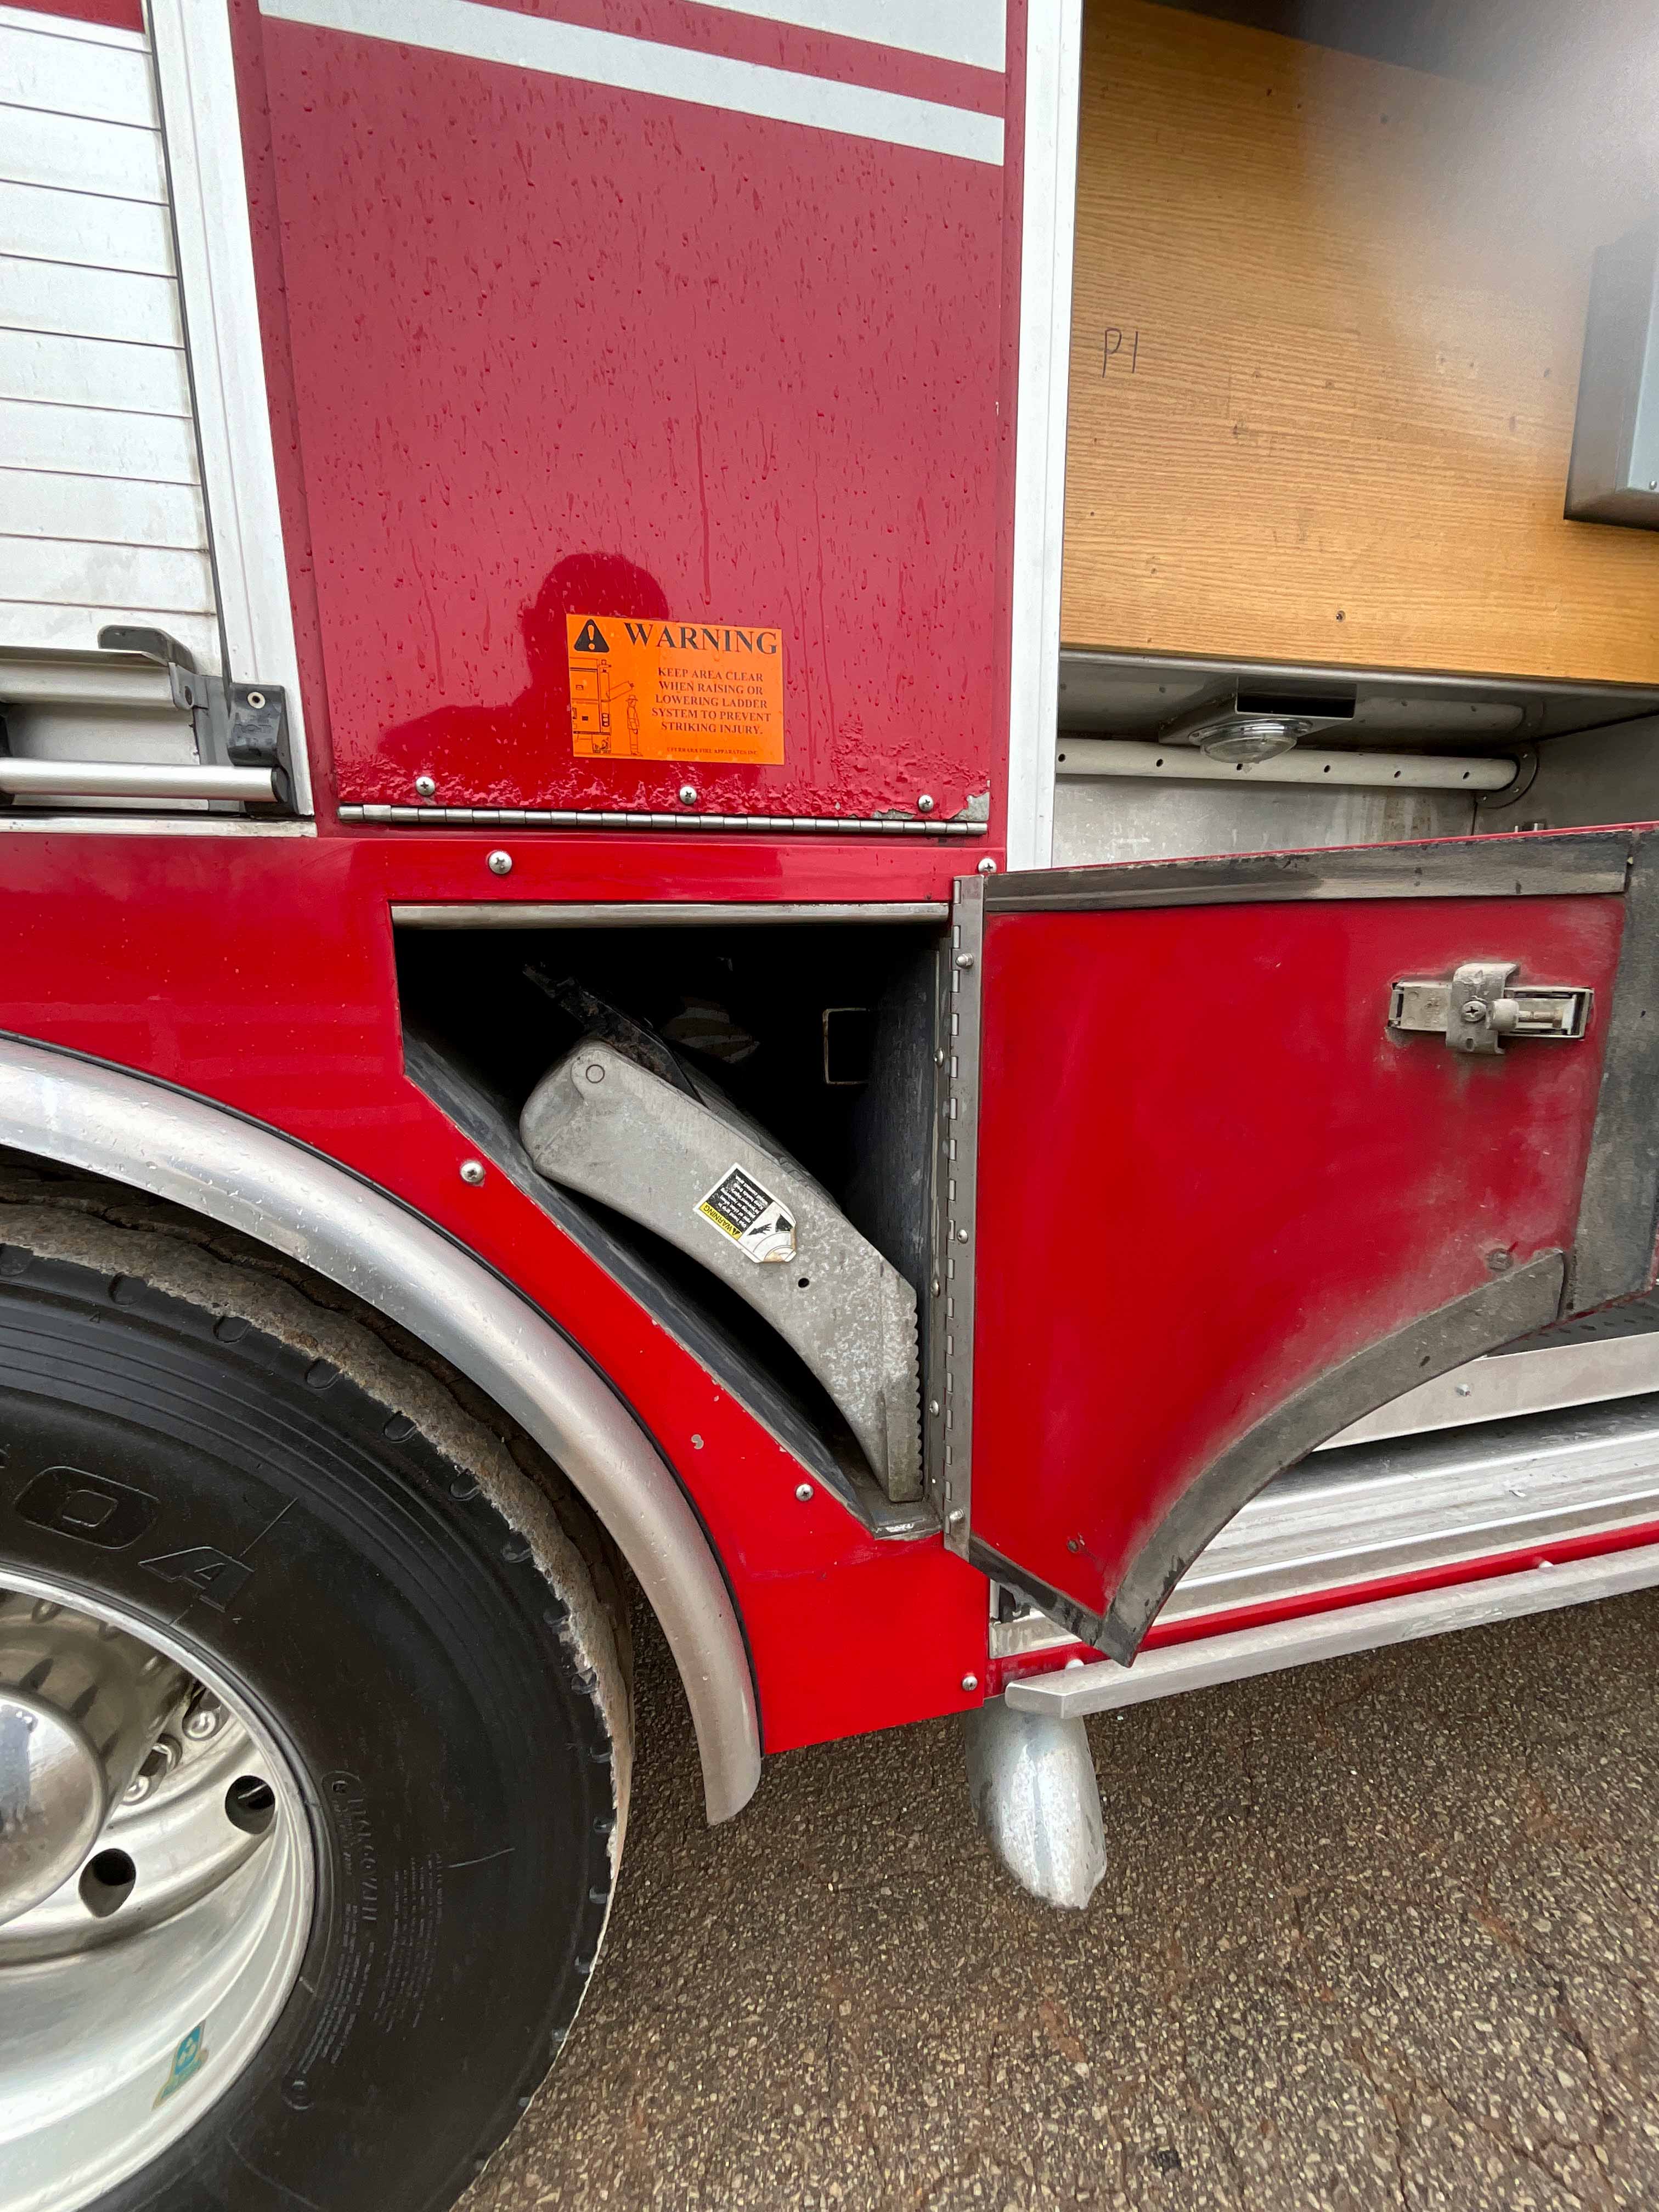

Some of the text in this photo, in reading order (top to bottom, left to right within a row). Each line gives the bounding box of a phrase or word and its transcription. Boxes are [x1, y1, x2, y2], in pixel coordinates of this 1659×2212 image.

[624, 622, 777, 654] WARNING
[658, 667, 763, 681] KEEP AREA CLEAR
[659, 681, 763, 695] WHEN RAISING OR
[655, 694, 768, 708] LOWERING LADDER
[652, 707, 771, 722] SYSTEM TO PREVENT
[661, 721, 763, 735] STRIKING INJURY.
[703, 1205, 732, 1231] WARNING
